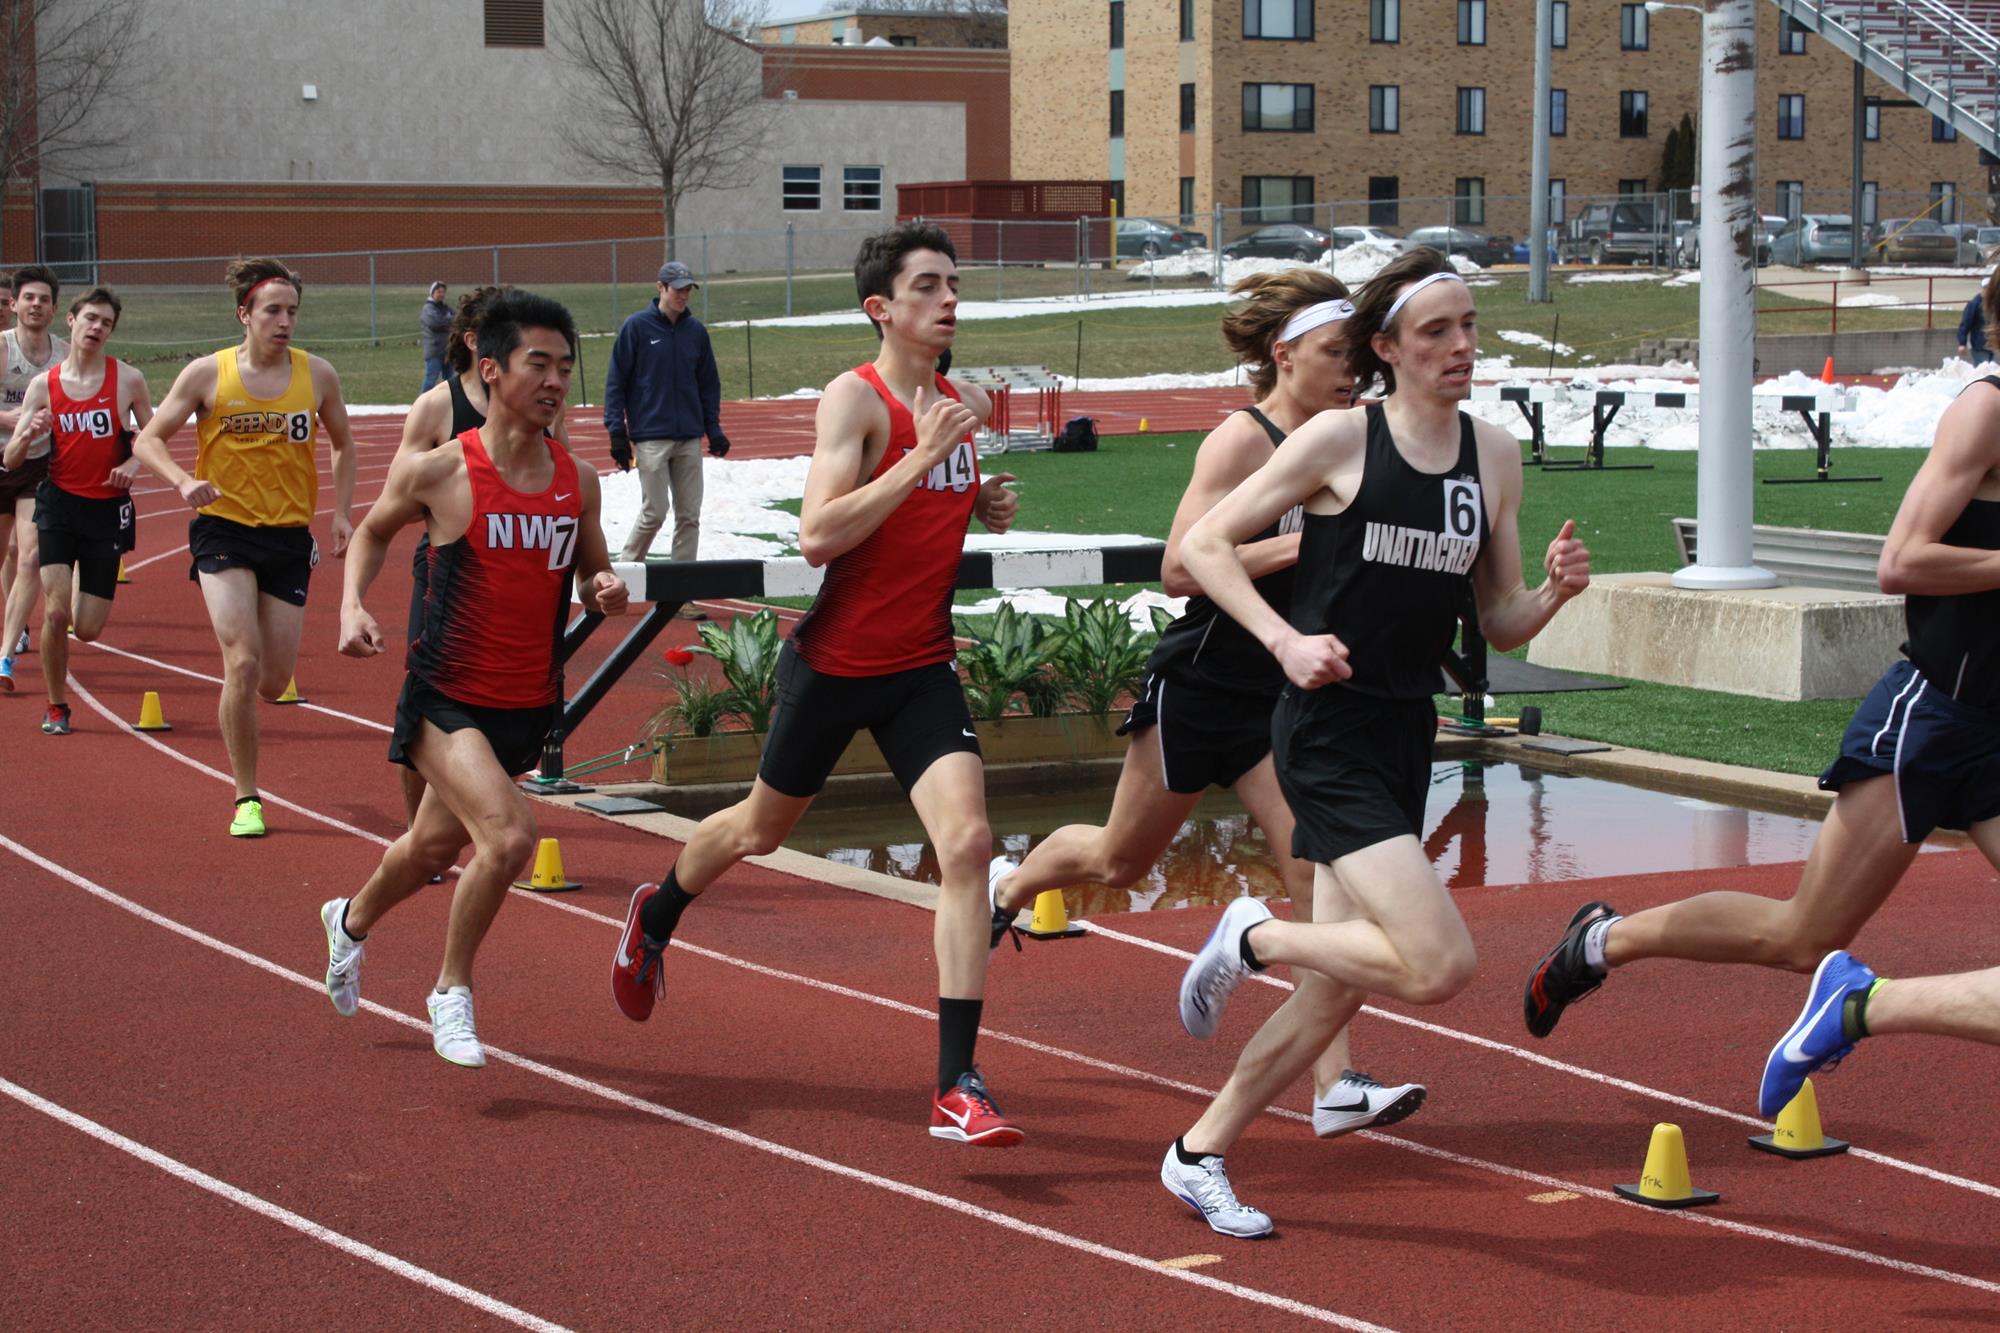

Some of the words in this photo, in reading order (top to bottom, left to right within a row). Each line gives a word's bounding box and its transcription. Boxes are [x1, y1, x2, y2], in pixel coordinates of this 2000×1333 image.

[92, 411, 109, 436] 9
[291, 413, 308, 441] 8
[1449, 485, 1476, 538] 6
[485, 514, 573, 549] NW
[555, 523, 575, 566] 7
